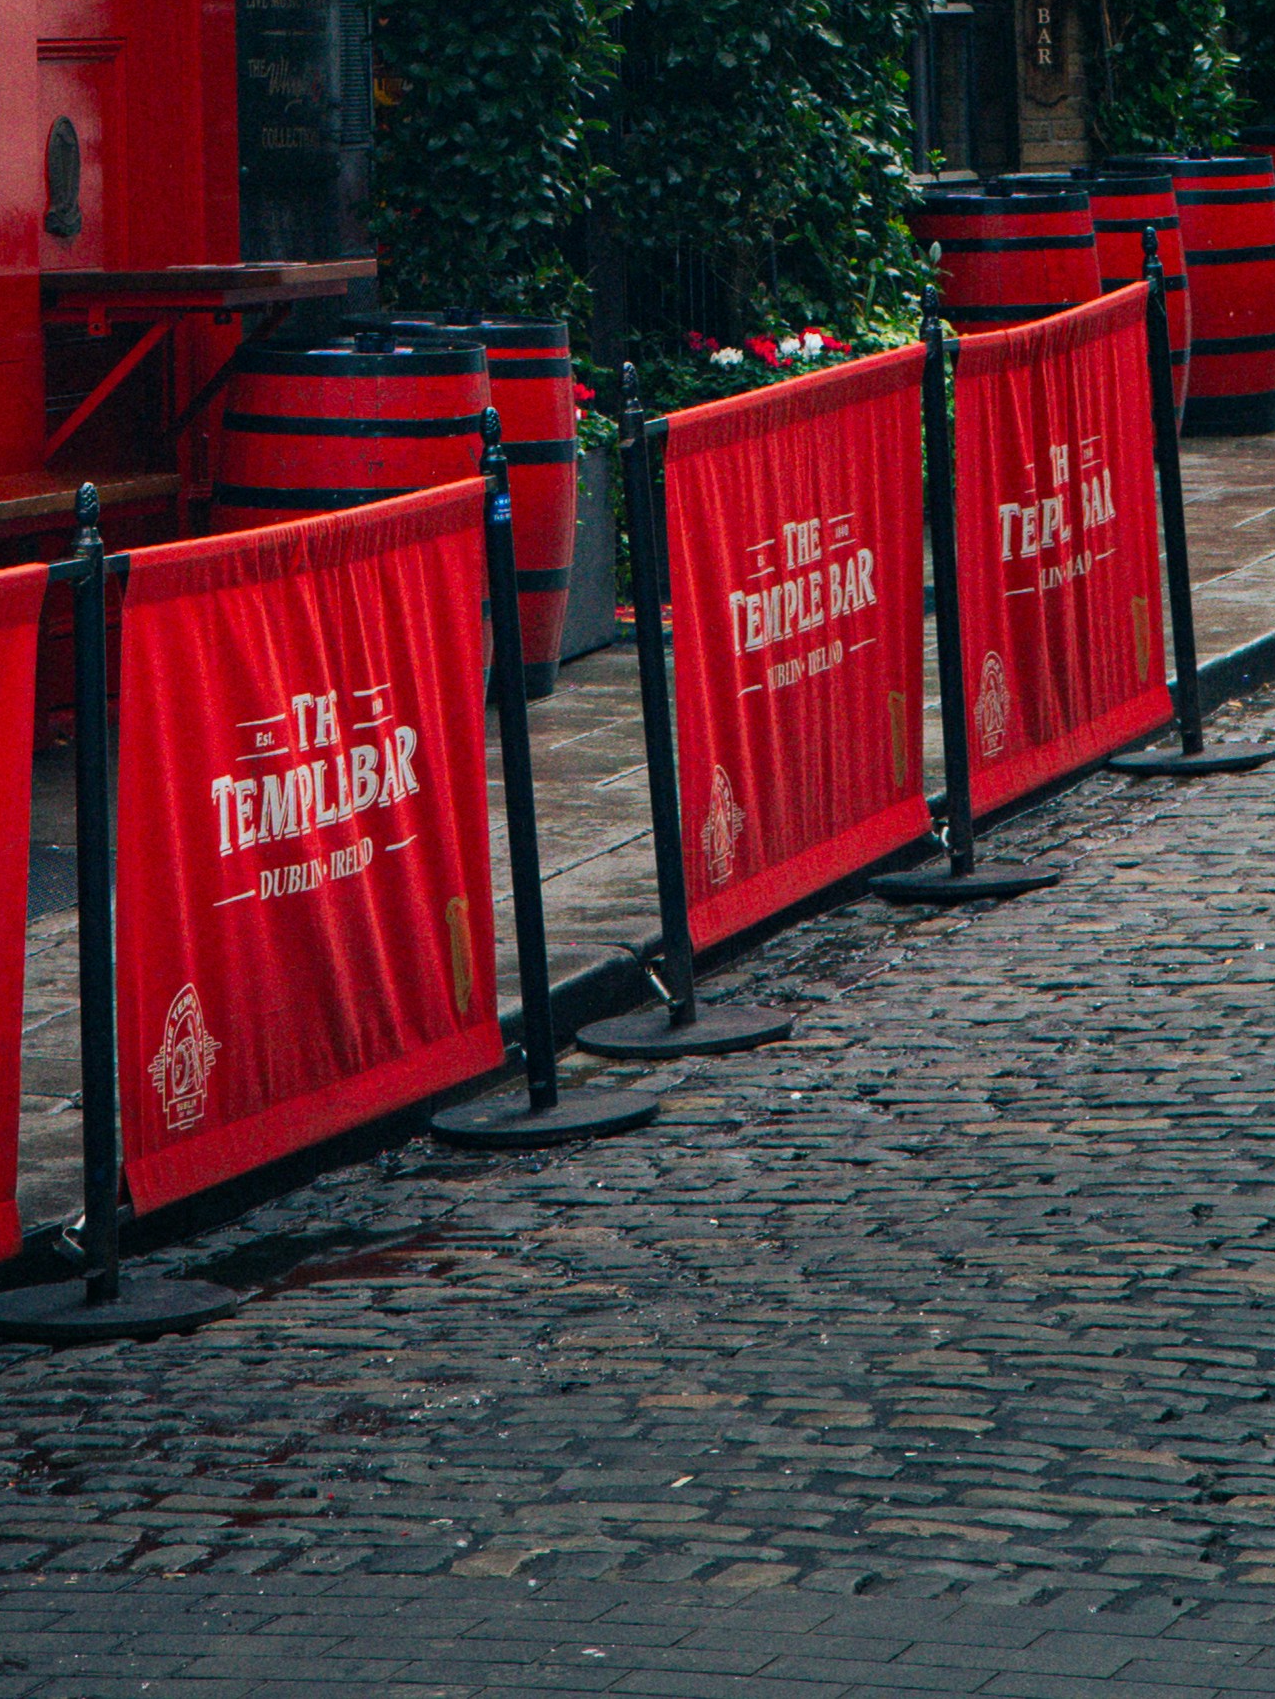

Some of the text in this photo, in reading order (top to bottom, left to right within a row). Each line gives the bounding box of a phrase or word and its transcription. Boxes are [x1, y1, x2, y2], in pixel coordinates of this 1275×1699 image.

[1037, 7, 1053, 65] BAR
[1049, 443, 1072, 490] TH
[782, 517, 824, 571] THE
[998, 497, 1073, 562] TEPL
[729, 547, 878, 657] TEMPLE BAR
[255, 689, 343, 754] Est. TH
